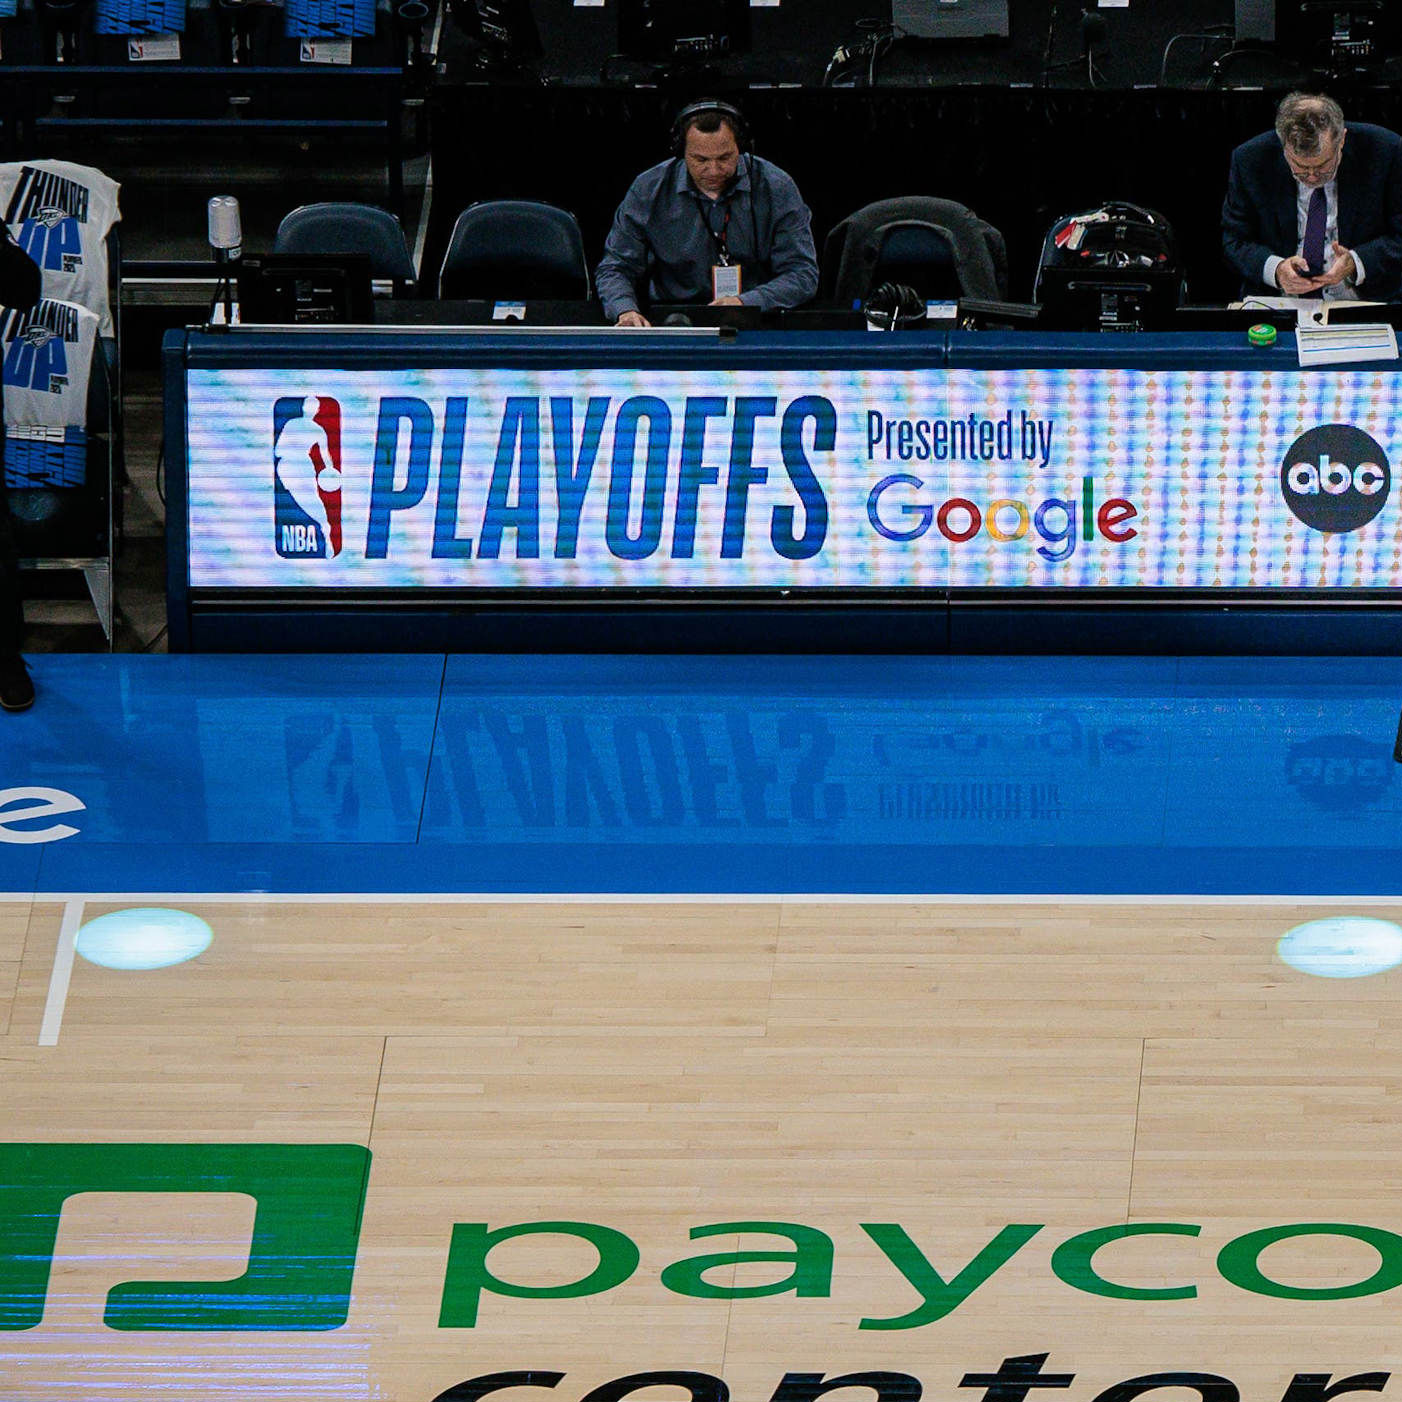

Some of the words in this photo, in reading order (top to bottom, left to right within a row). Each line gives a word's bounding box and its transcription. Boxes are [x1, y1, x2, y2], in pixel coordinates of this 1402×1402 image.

[5, 165, 89, 224] THUNDER
[18, 216, 82, 271] UP
[867, 410, 1012, 460] Presented
[1021, 410, 1053, 468] by
[365, 395, 837, 560] PLAYOFFS
[1287, 454, 1384, 495] abc
[281, 523, 319, 554] NBA
[867, 473, 1138, 562] Google
